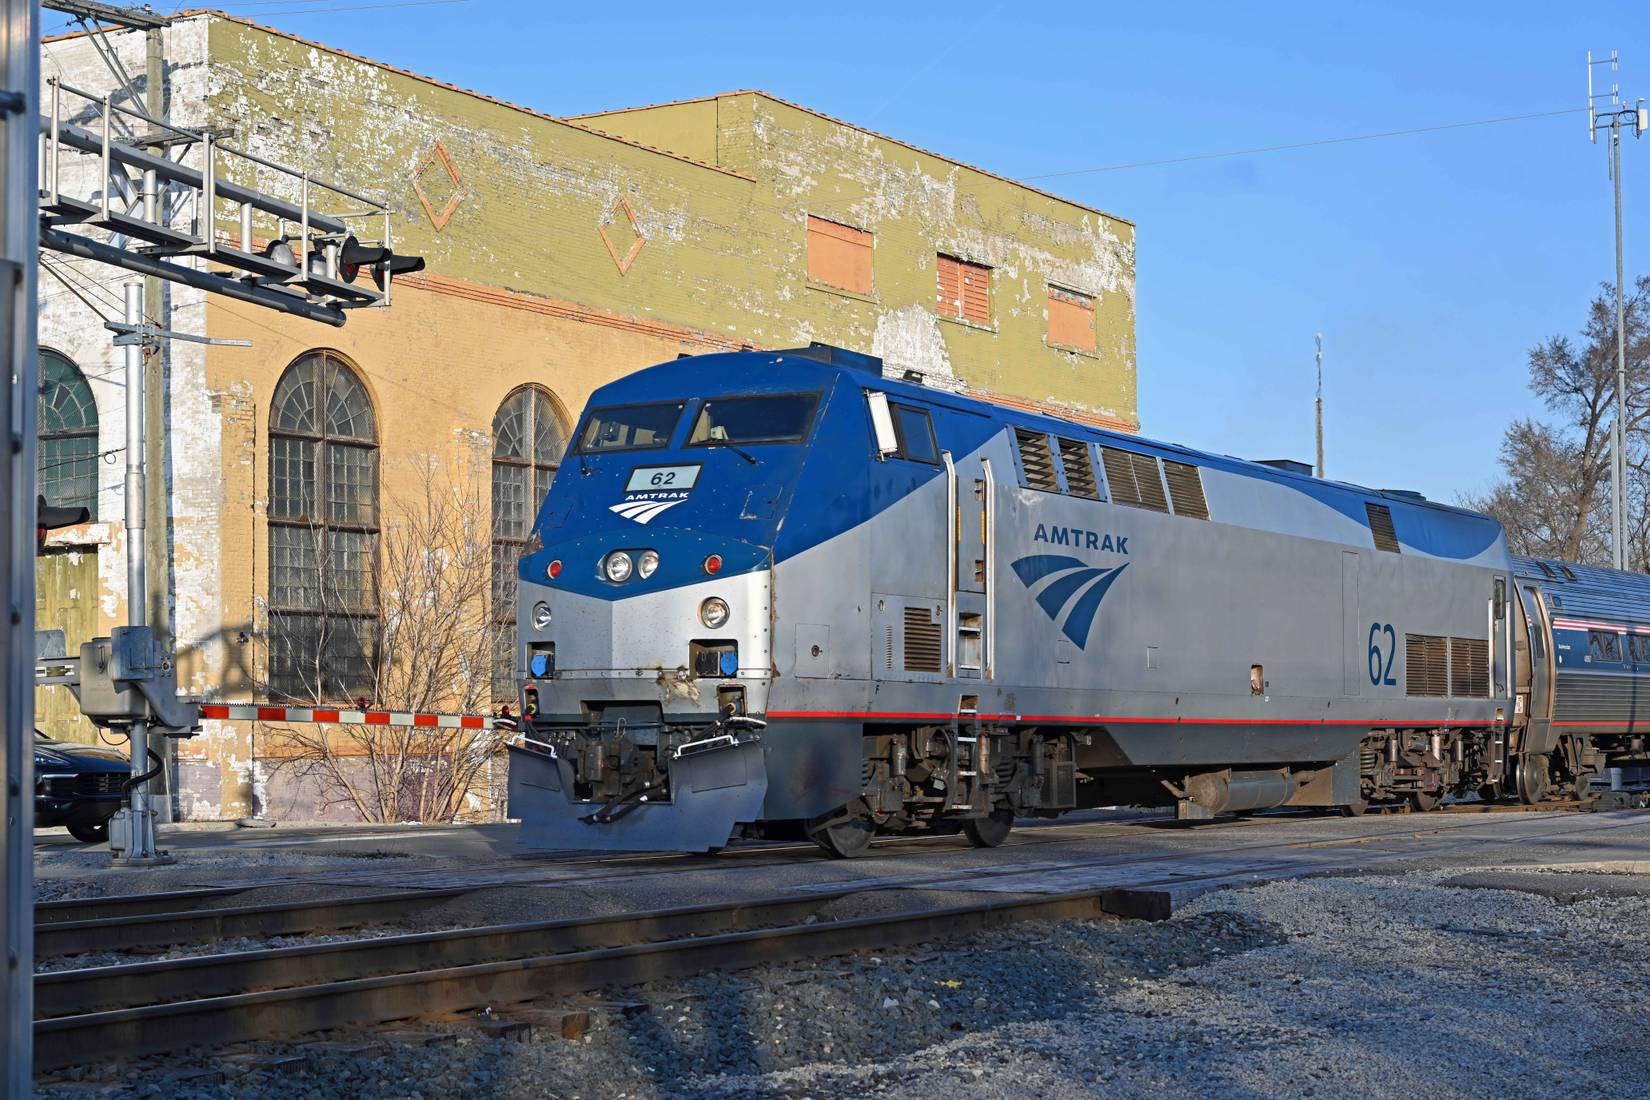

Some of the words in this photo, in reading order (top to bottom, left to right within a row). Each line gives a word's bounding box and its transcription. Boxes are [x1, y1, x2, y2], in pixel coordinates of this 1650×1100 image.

[650, 471, 676, 486] 62
[624, 492, 689, 501] AMTRAK
[1033, 523, 1129, 555] AMTRAK
[1368, 622, 1397, 686] 62
